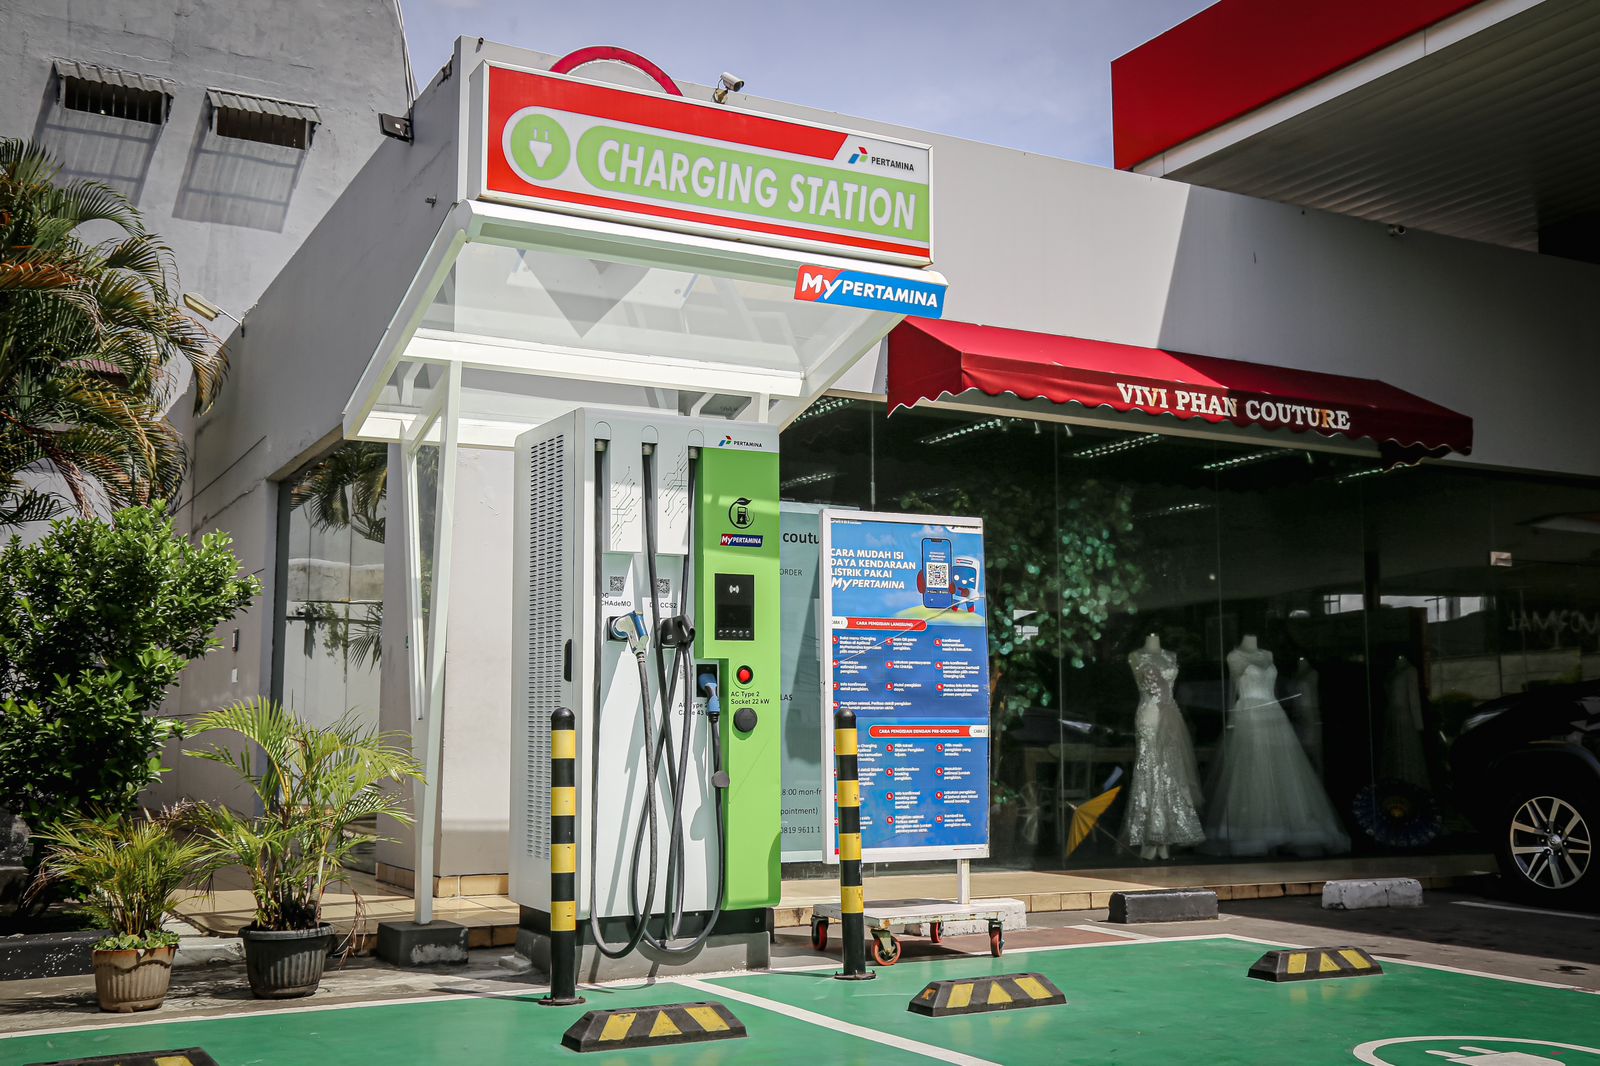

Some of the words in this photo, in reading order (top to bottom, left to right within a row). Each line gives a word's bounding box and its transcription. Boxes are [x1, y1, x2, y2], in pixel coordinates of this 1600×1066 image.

[871, 156, 914, 172] PERTAMINA
[598, 139, 778, 208] CHARGING
[787, 173, 916, 231] STATION
[1116, 382, 1169, 409] VIVI
[1175, 390, 1238, 418] PHAN
[1246, 399, 1351, 431] COUTURE
[733, 440, 763, 449] PERTAMINA
[831, 548, 854, 558] CARA
[857, 550, 892, 560] MUDAH
[894, 551, 905, 560] ISI
[831, 557, 857, 568] DAYA
[858, 559, 917, 571] KENDARAAN
[779, 568, 803, 577] ORDER
[831, 567, 863, 578] LISTRIK
[863, 569, 893, 579] PAKAI
[780, 807, 819, 816] pointment)
